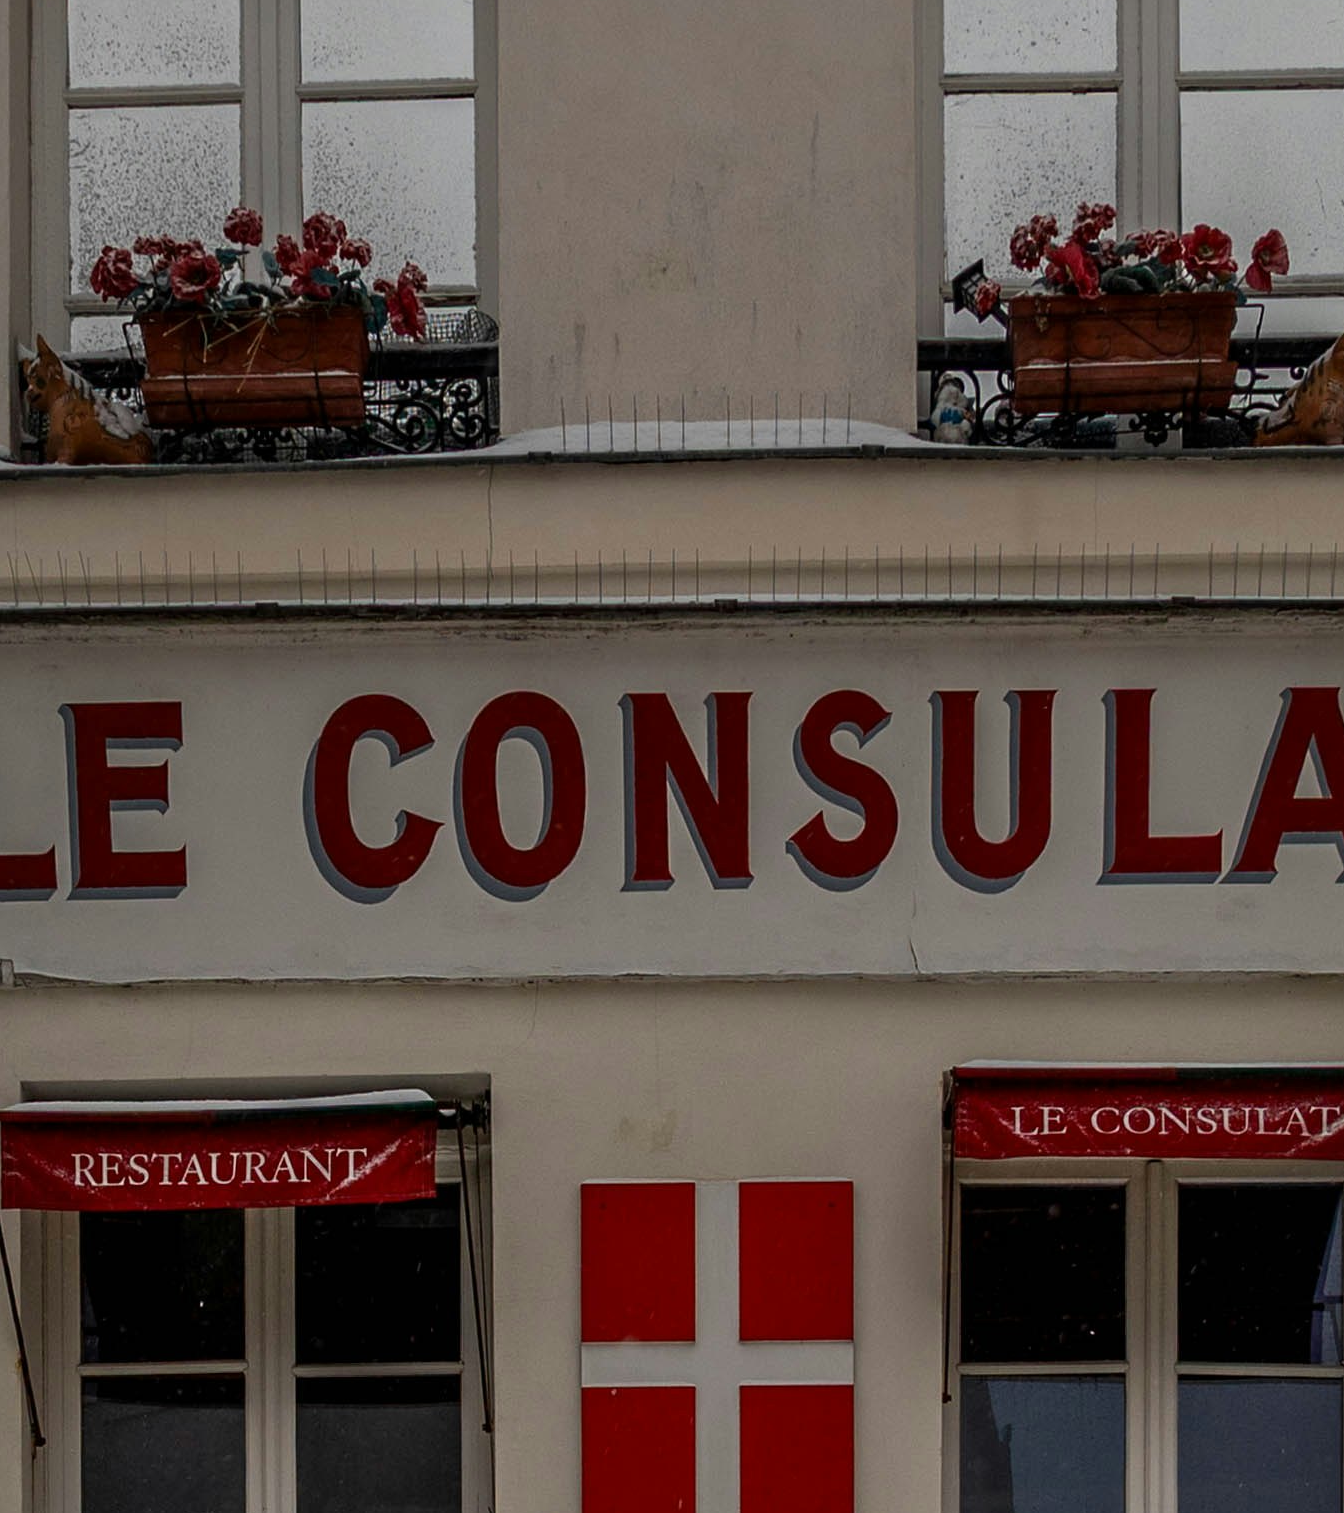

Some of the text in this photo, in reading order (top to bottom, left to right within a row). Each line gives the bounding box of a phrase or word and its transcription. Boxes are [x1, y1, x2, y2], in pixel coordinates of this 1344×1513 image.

[1010, 1102, 1340, 1139] LE CONSULAT
[70, 1147, 369, 1189] RESTAURANT
